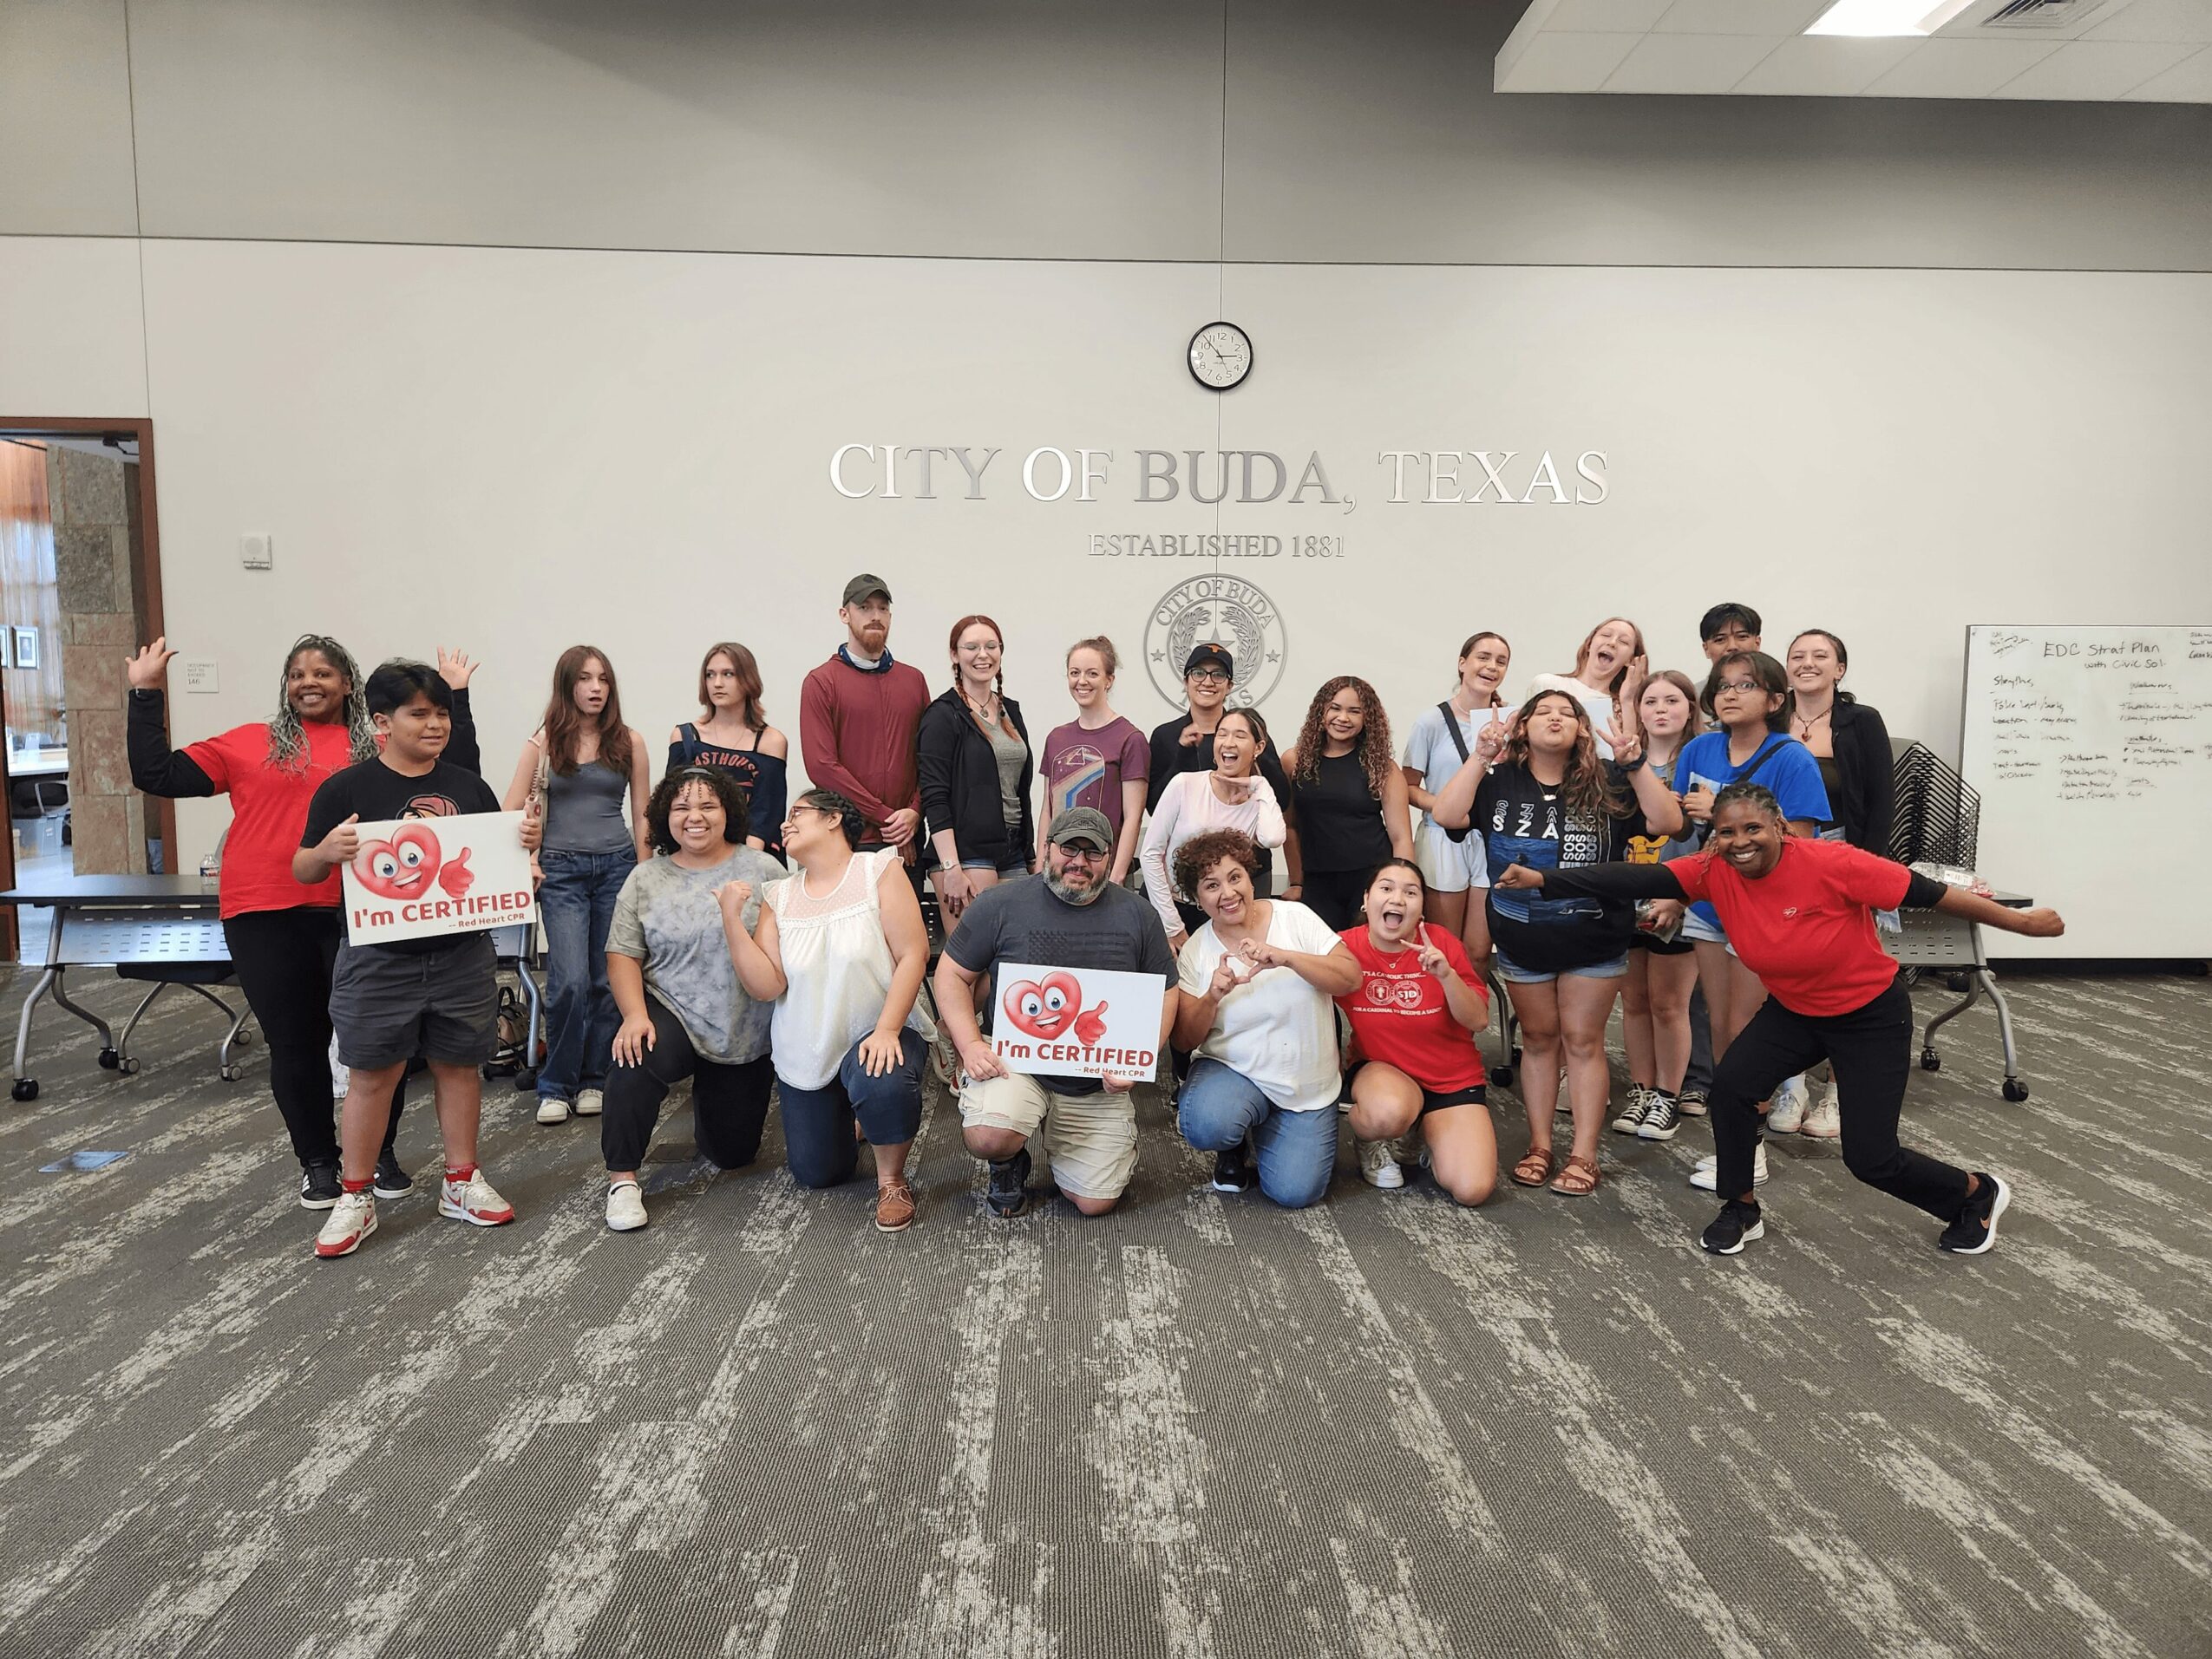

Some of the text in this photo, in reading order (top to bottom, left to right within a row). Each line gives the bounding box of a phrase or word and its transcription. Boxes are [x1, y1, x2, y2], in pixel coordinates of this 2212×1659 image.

[1217, 332, 1227, 341] 12
[1234, 343, 1241, 352] 2
[1197, 351, 1204, 360] 9
[1236, 354, 1243, 362] 3
[828, 443, 1611, 514] CITY OF BUDA, TEXAS
[1087, 534, 1345, 558] ESTABLISHED 1881
[1155, 579, 1275, 630] CITY OF BUDA
[2044, 642, 2081, 657] EDC
[2087, 641, 2126, 656] Strat
[2131, 641, 2160, 654] Plan
[695, 752, 760, 778] ASTHOUS
[1562, 833, 1575, 861] SOS
[1574, 833, 1587, 861] SOS
[1586, 833, 1598, 861] SOS
[354, 891, 532, 928] I'm CERTIFIED
[458, 919, 477, 929] Red
[479, 915, 506, 925] Heart
[507, 912, 526, 922] CPR
[1397, 990, 1417, 1000] SJD
[997, 1040, 1155, 1068] I'm CERTIFIED
[1102, 1068, 1127, 1077] Heart
[1128, 1069, 1146, 1078] CPR
